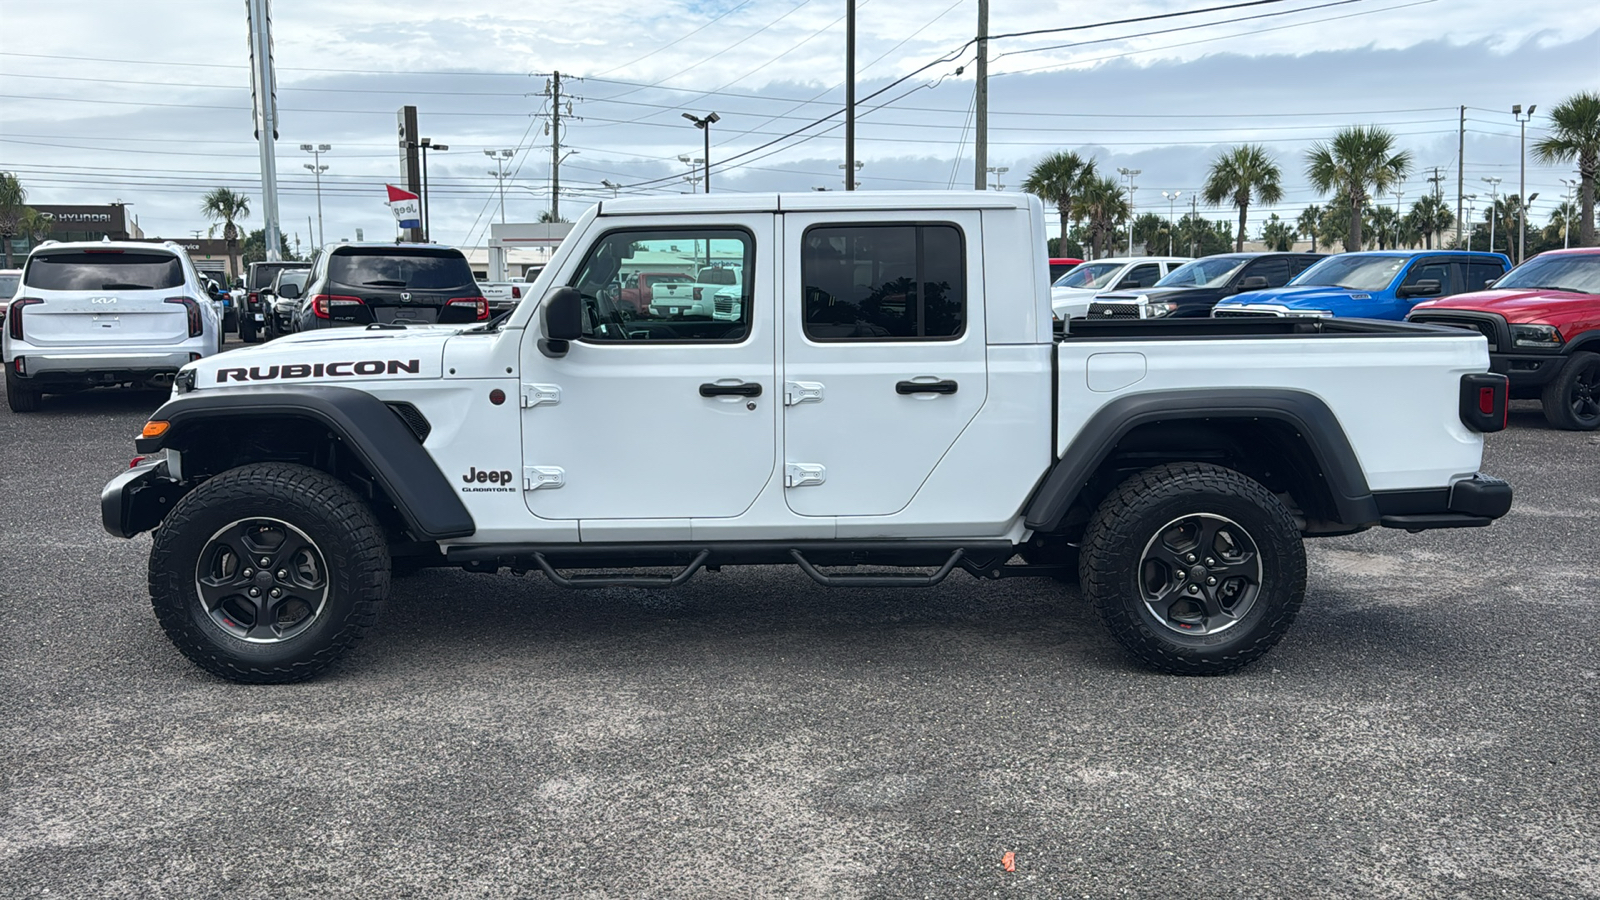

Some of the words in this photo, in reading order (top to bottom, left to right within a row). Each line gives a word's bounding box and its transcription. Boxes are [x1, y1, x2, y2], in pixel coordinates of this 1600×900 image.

[58, 213, 111, 222] HYUNDAI
[215, 358, 420, 384] RUBICON
[462, 466, 513, 486] Jeep
